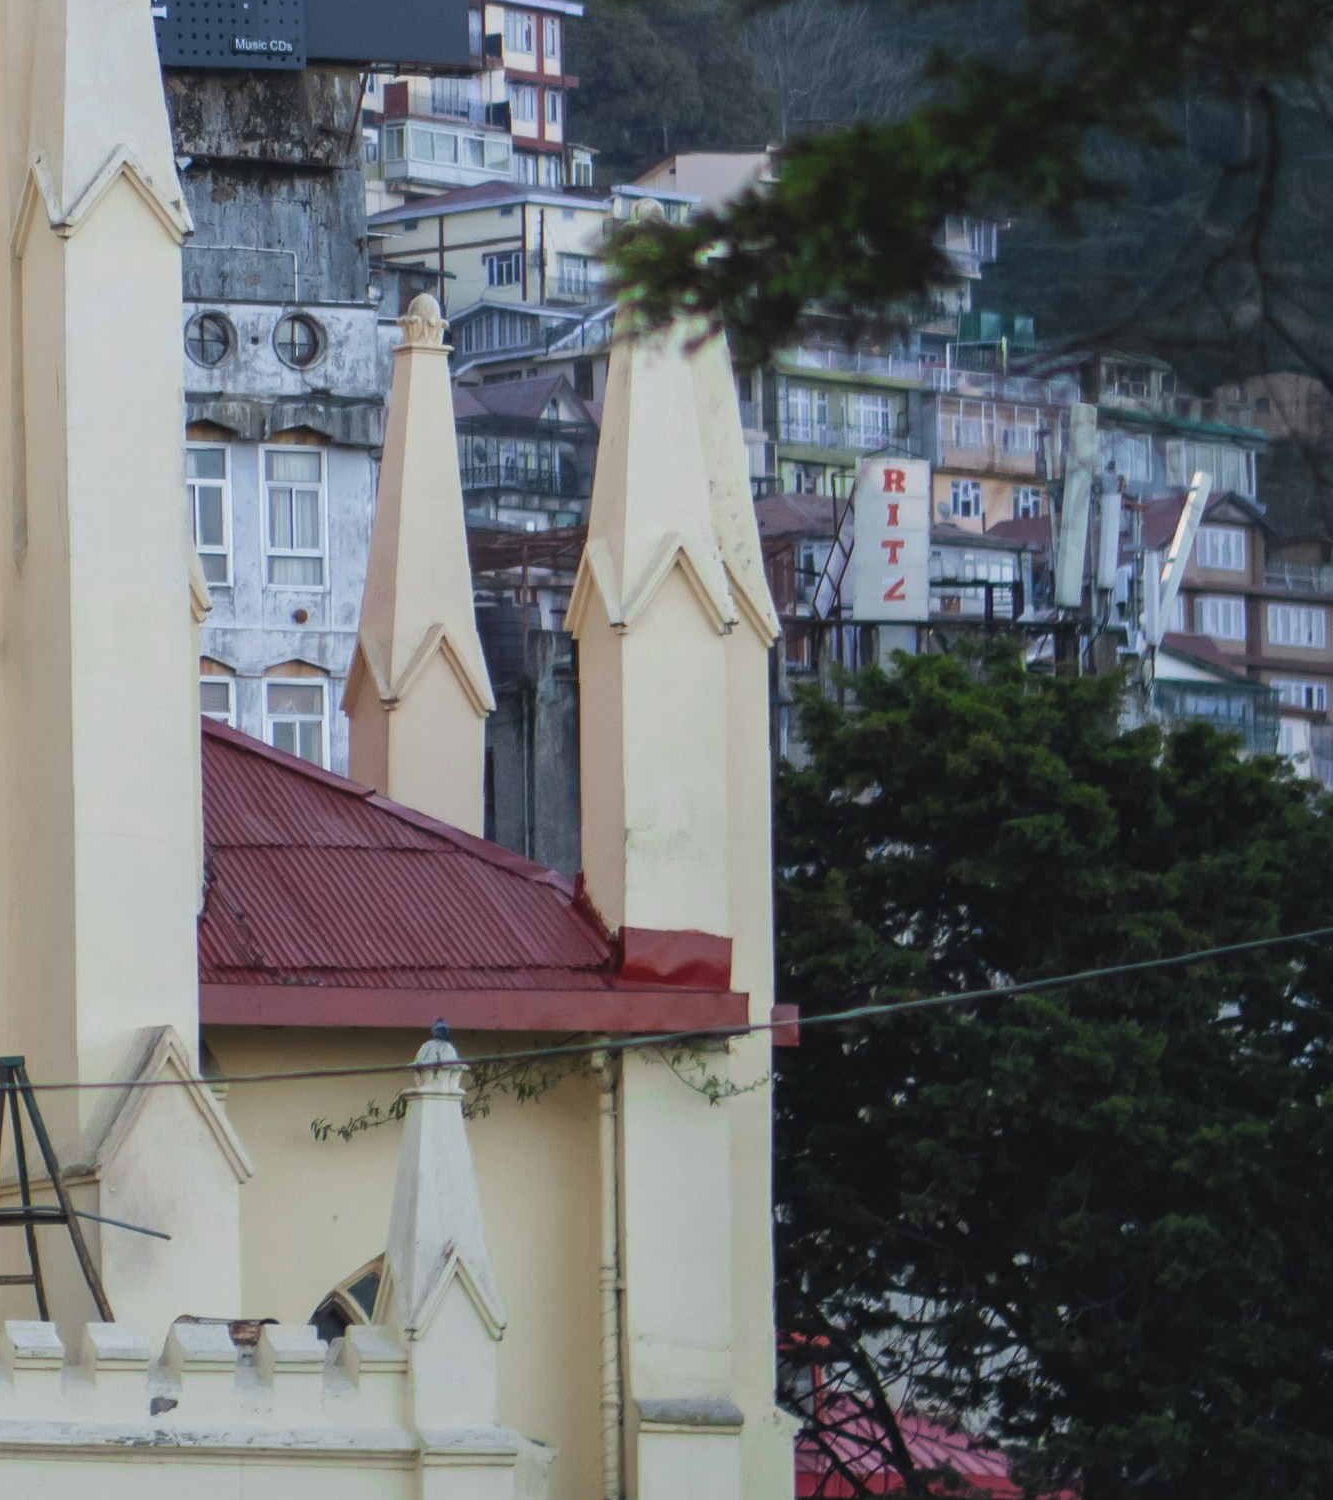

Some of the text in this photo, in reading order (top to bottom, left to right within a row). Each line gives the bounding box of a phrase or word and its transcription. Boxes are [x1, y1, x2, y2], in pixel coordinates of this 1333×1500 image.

[235, 37, 293, 52] Music CDs
[881, 468, 906, 602] RITZ
